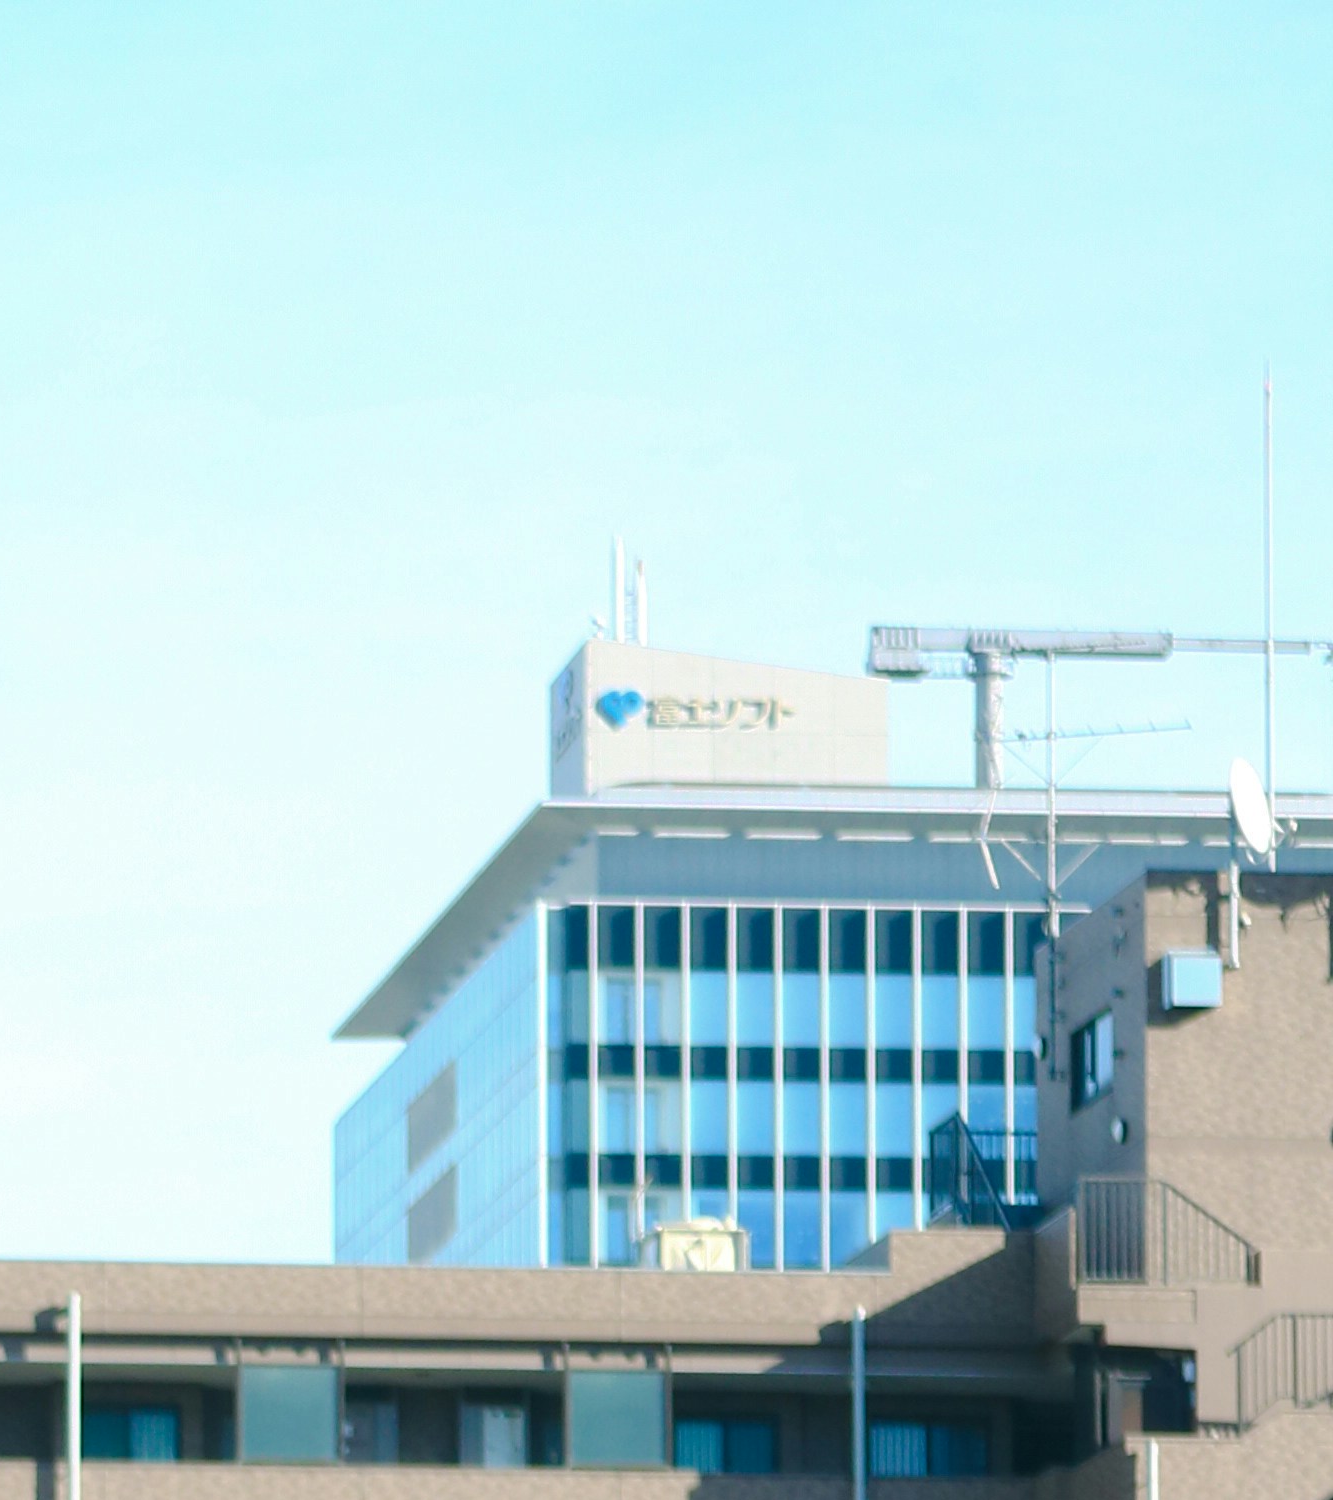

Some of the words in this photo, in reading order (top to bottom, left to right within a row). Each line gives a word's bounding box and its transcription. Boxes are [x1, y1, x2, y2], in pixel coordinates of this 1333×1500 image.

[647, 695, 795, 732] 富士ソフト
